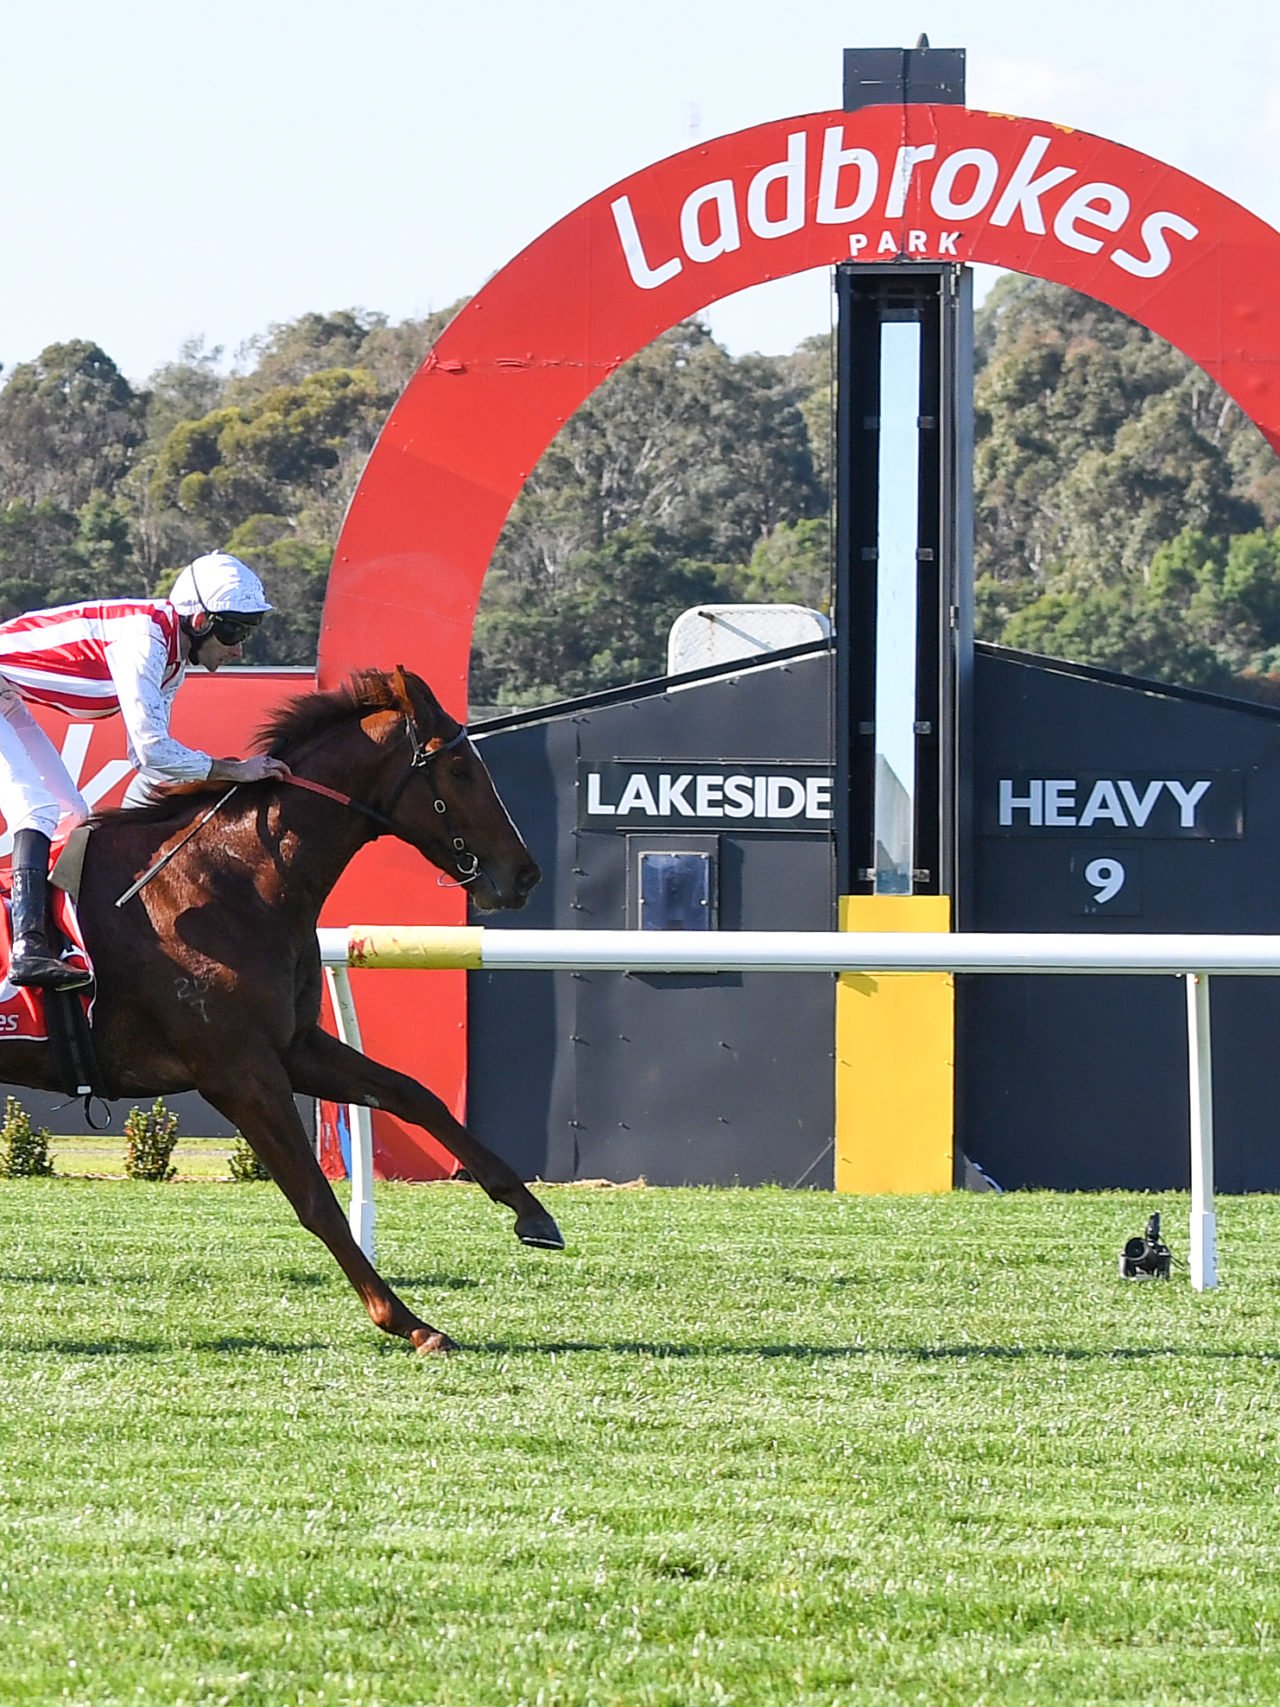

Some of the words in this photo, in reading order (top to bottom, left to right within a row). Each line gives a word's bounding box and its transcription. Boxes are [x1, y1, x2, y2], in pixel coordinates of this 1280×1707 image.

[610, 126, 1199, 290] Ladbrokes
[848, 230, 962, 257] PARK
[587, 773, 835, 819] LAKESIDE
[999, 779, 1212, 828] HEAVY
[1084, 858, 1125, 904] 9
